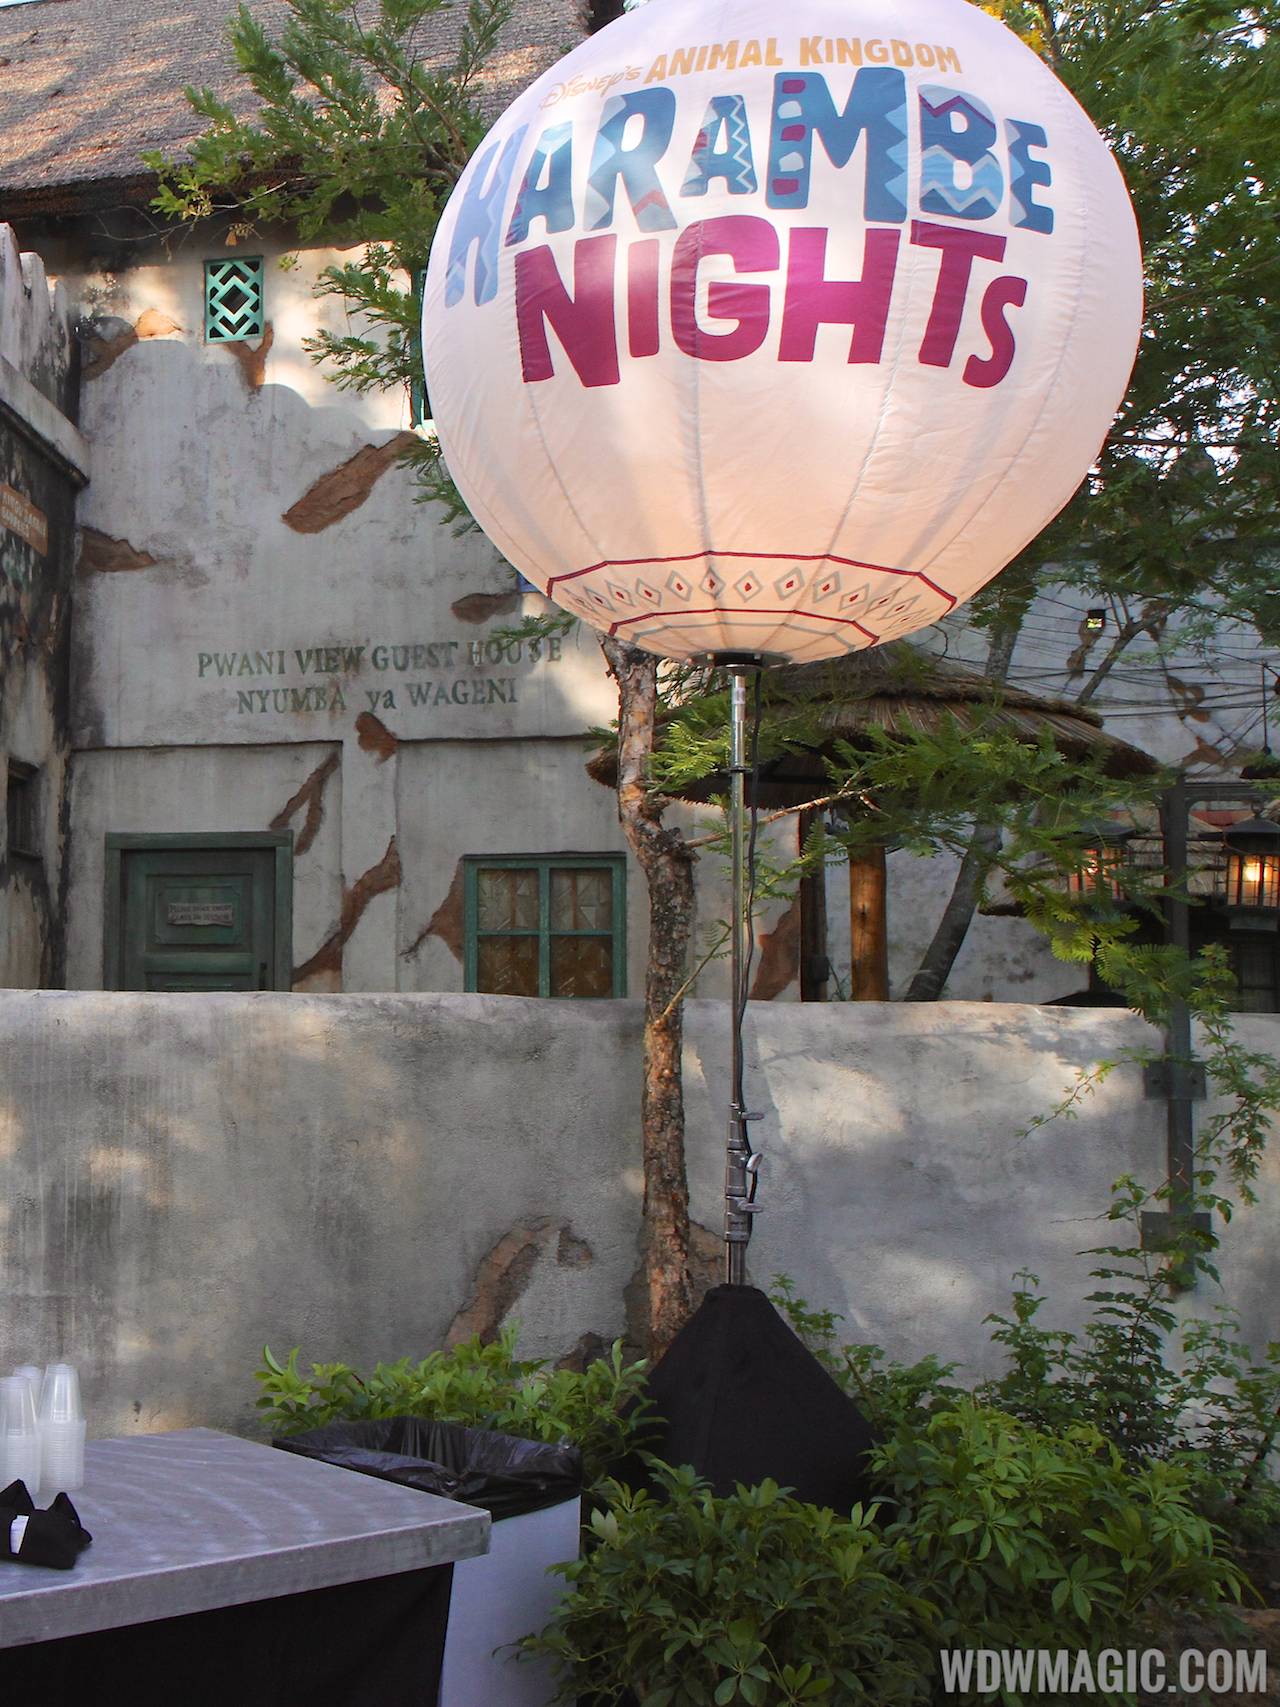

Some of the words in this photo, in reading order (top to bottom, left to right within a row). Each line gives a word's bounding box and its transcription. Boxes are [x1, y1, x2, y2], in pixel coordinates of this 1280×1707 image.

[643, 37, 784, 85] ANIMAL
[799, 35, 963, 74] KINGDOM
[444, 66, 1055, 308] HARAMBE
[513, 214, 1029, 389] NIGHTS
[197, 649, 286, 678] PWANI
[294, 645, 366, 675] VIEW
[370, 641, 459, 671] GUEST
[467, 636, 563, 668] HOUSE
[236, 685, 348, 714] NYUMBA
[365, 689, 397, 714] ya
[405, 677, 519, 708] WAGENI
